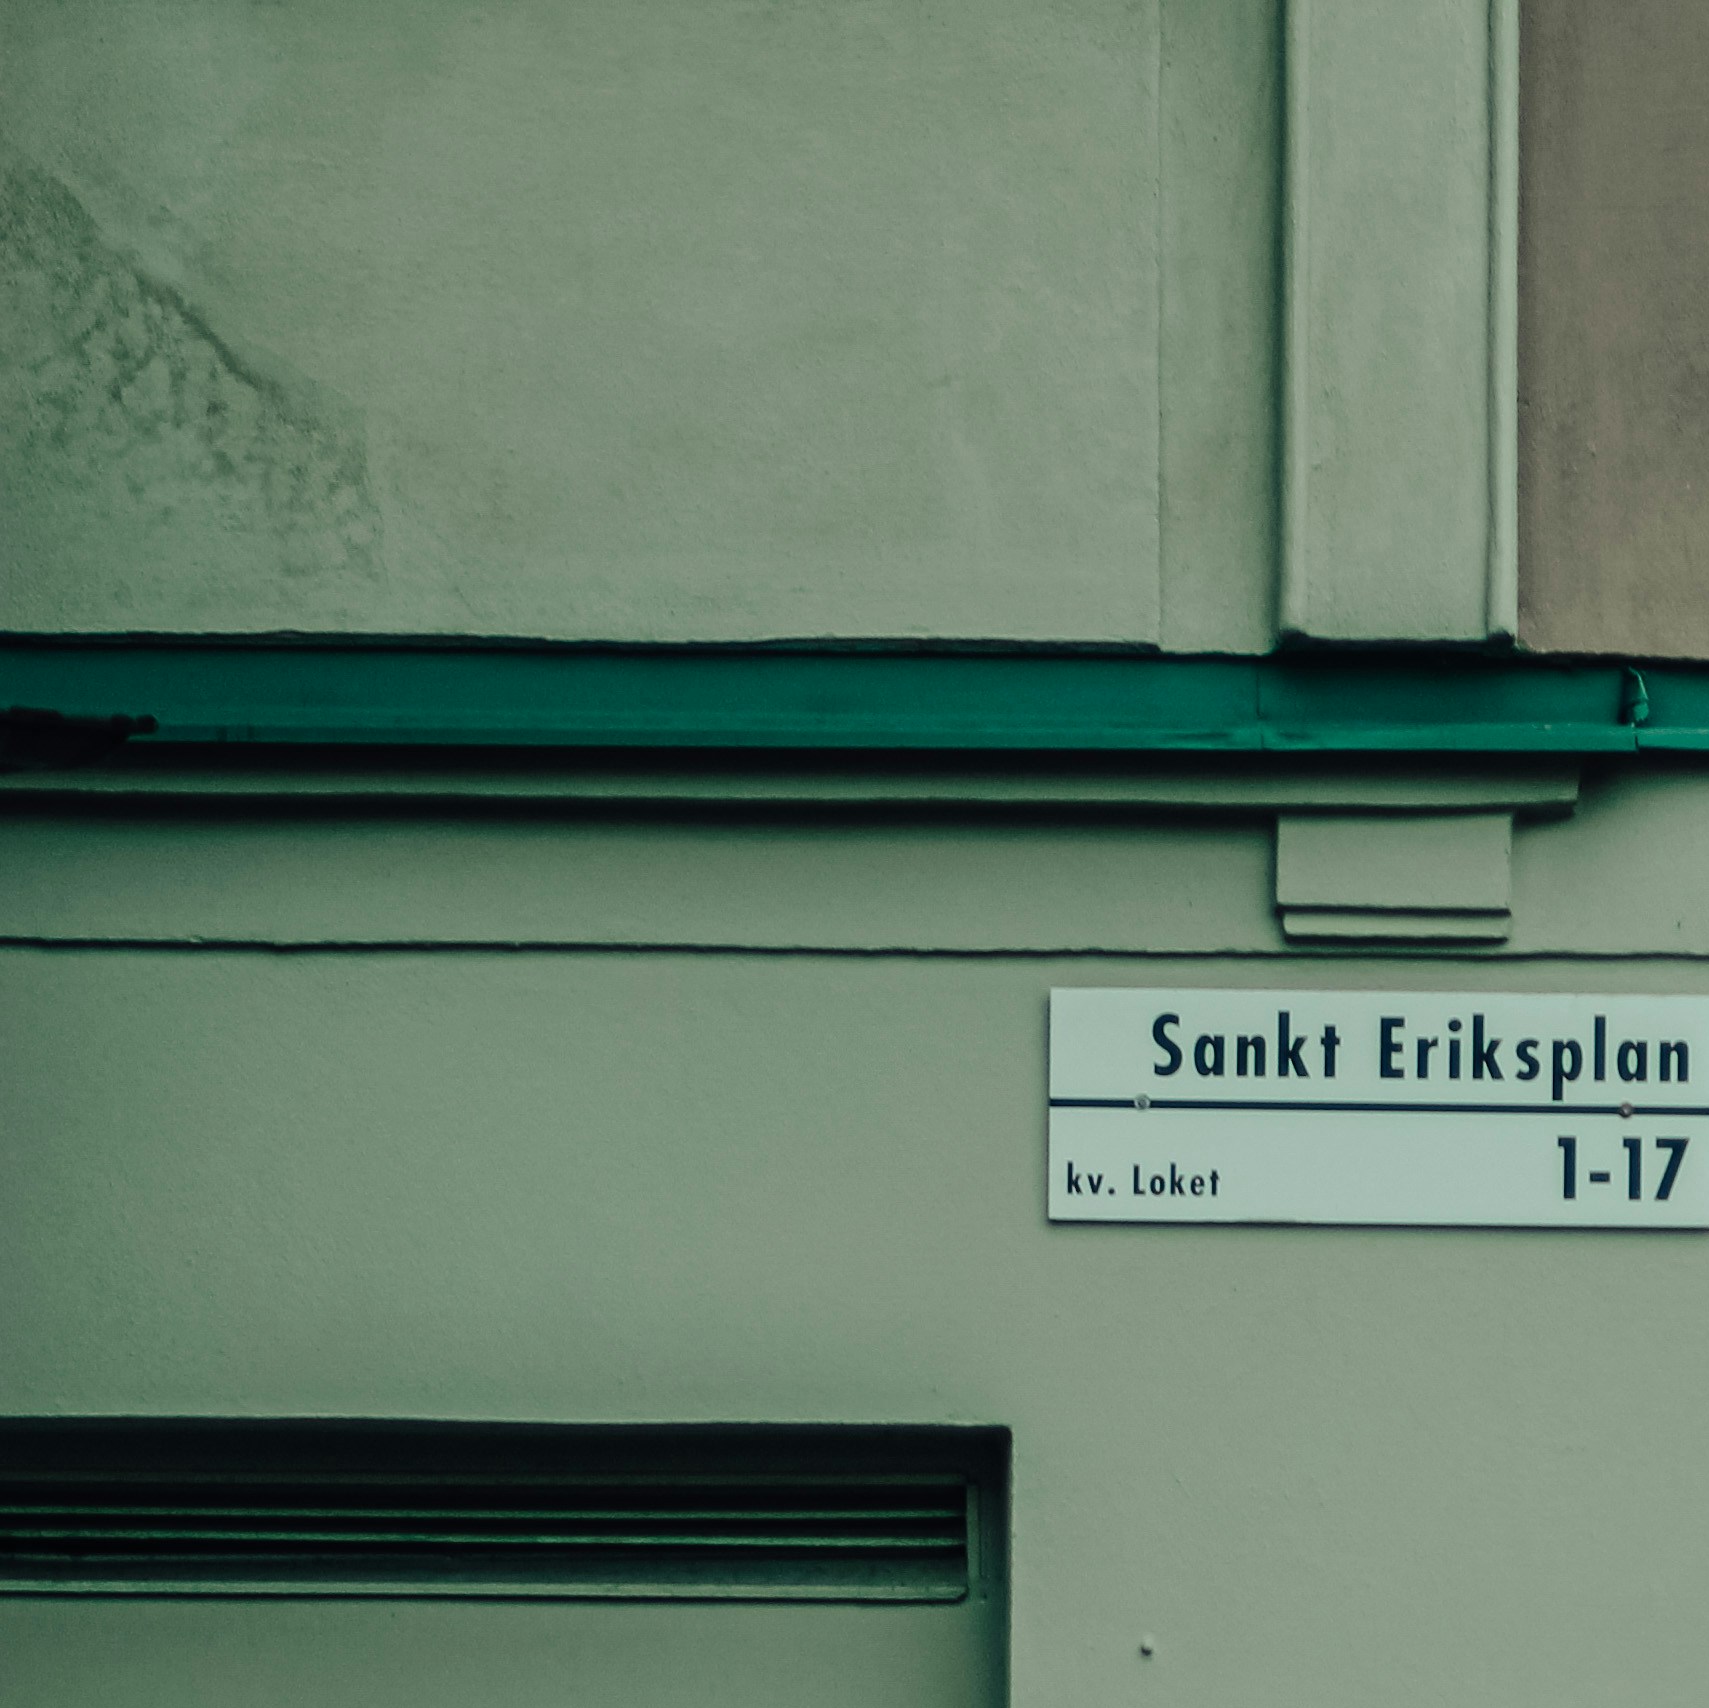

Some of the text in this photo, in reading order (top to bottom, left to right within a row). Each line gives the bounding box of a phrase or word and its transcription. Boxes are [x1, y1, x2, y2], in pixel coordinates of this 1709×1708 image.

[1152, 1011, 1689, 1101] Sankt Eriksplan
[1067, 1162, 1220, 1196] kv. Loket
[1557, 1136, 1689, 1200] 1-17
